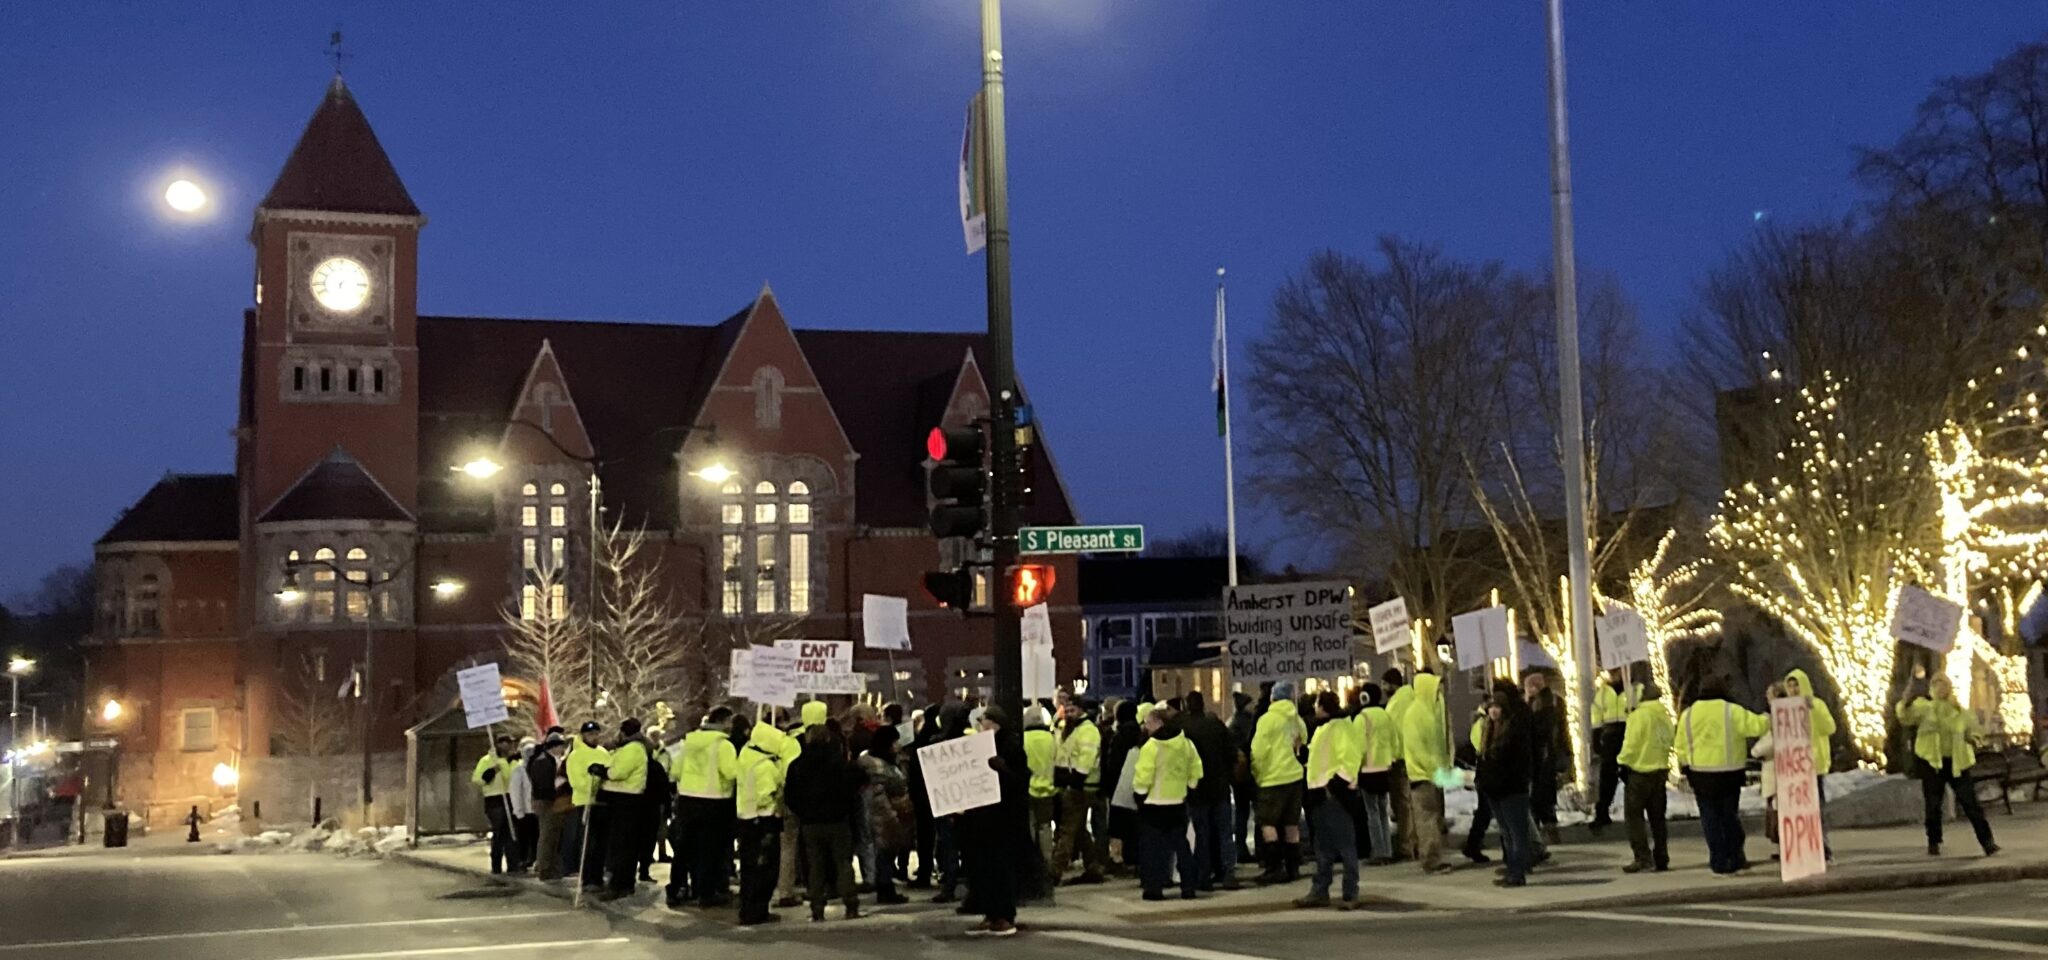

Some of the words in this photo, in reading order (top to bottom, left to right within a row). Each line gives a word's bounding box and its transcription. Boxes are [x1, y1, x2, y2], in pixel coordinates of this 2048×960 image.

[1027, 531, 1038, 549] S
[1046, 529, 1116, 549] Pleasant
[1123, 534, 1135, 547] St
[1304, 589, 1345, 606] DPW
[800, 643, 839, 658] CANT
[1228, 637, 1306, 659] Collapsing
[1276, 657, 1305, 674] and
[1776, 704, 1810, 740] FAIR
[920, 741, 973, 766] MAKE
[1774, 745, 1814, 776] WAGES
[938, 758, 980, 780] SOME
[933, 771, 995, 811] NOISE
[1788, 780, 1811, 806] FOR
[1783, 812, 1821, 864] DPW
